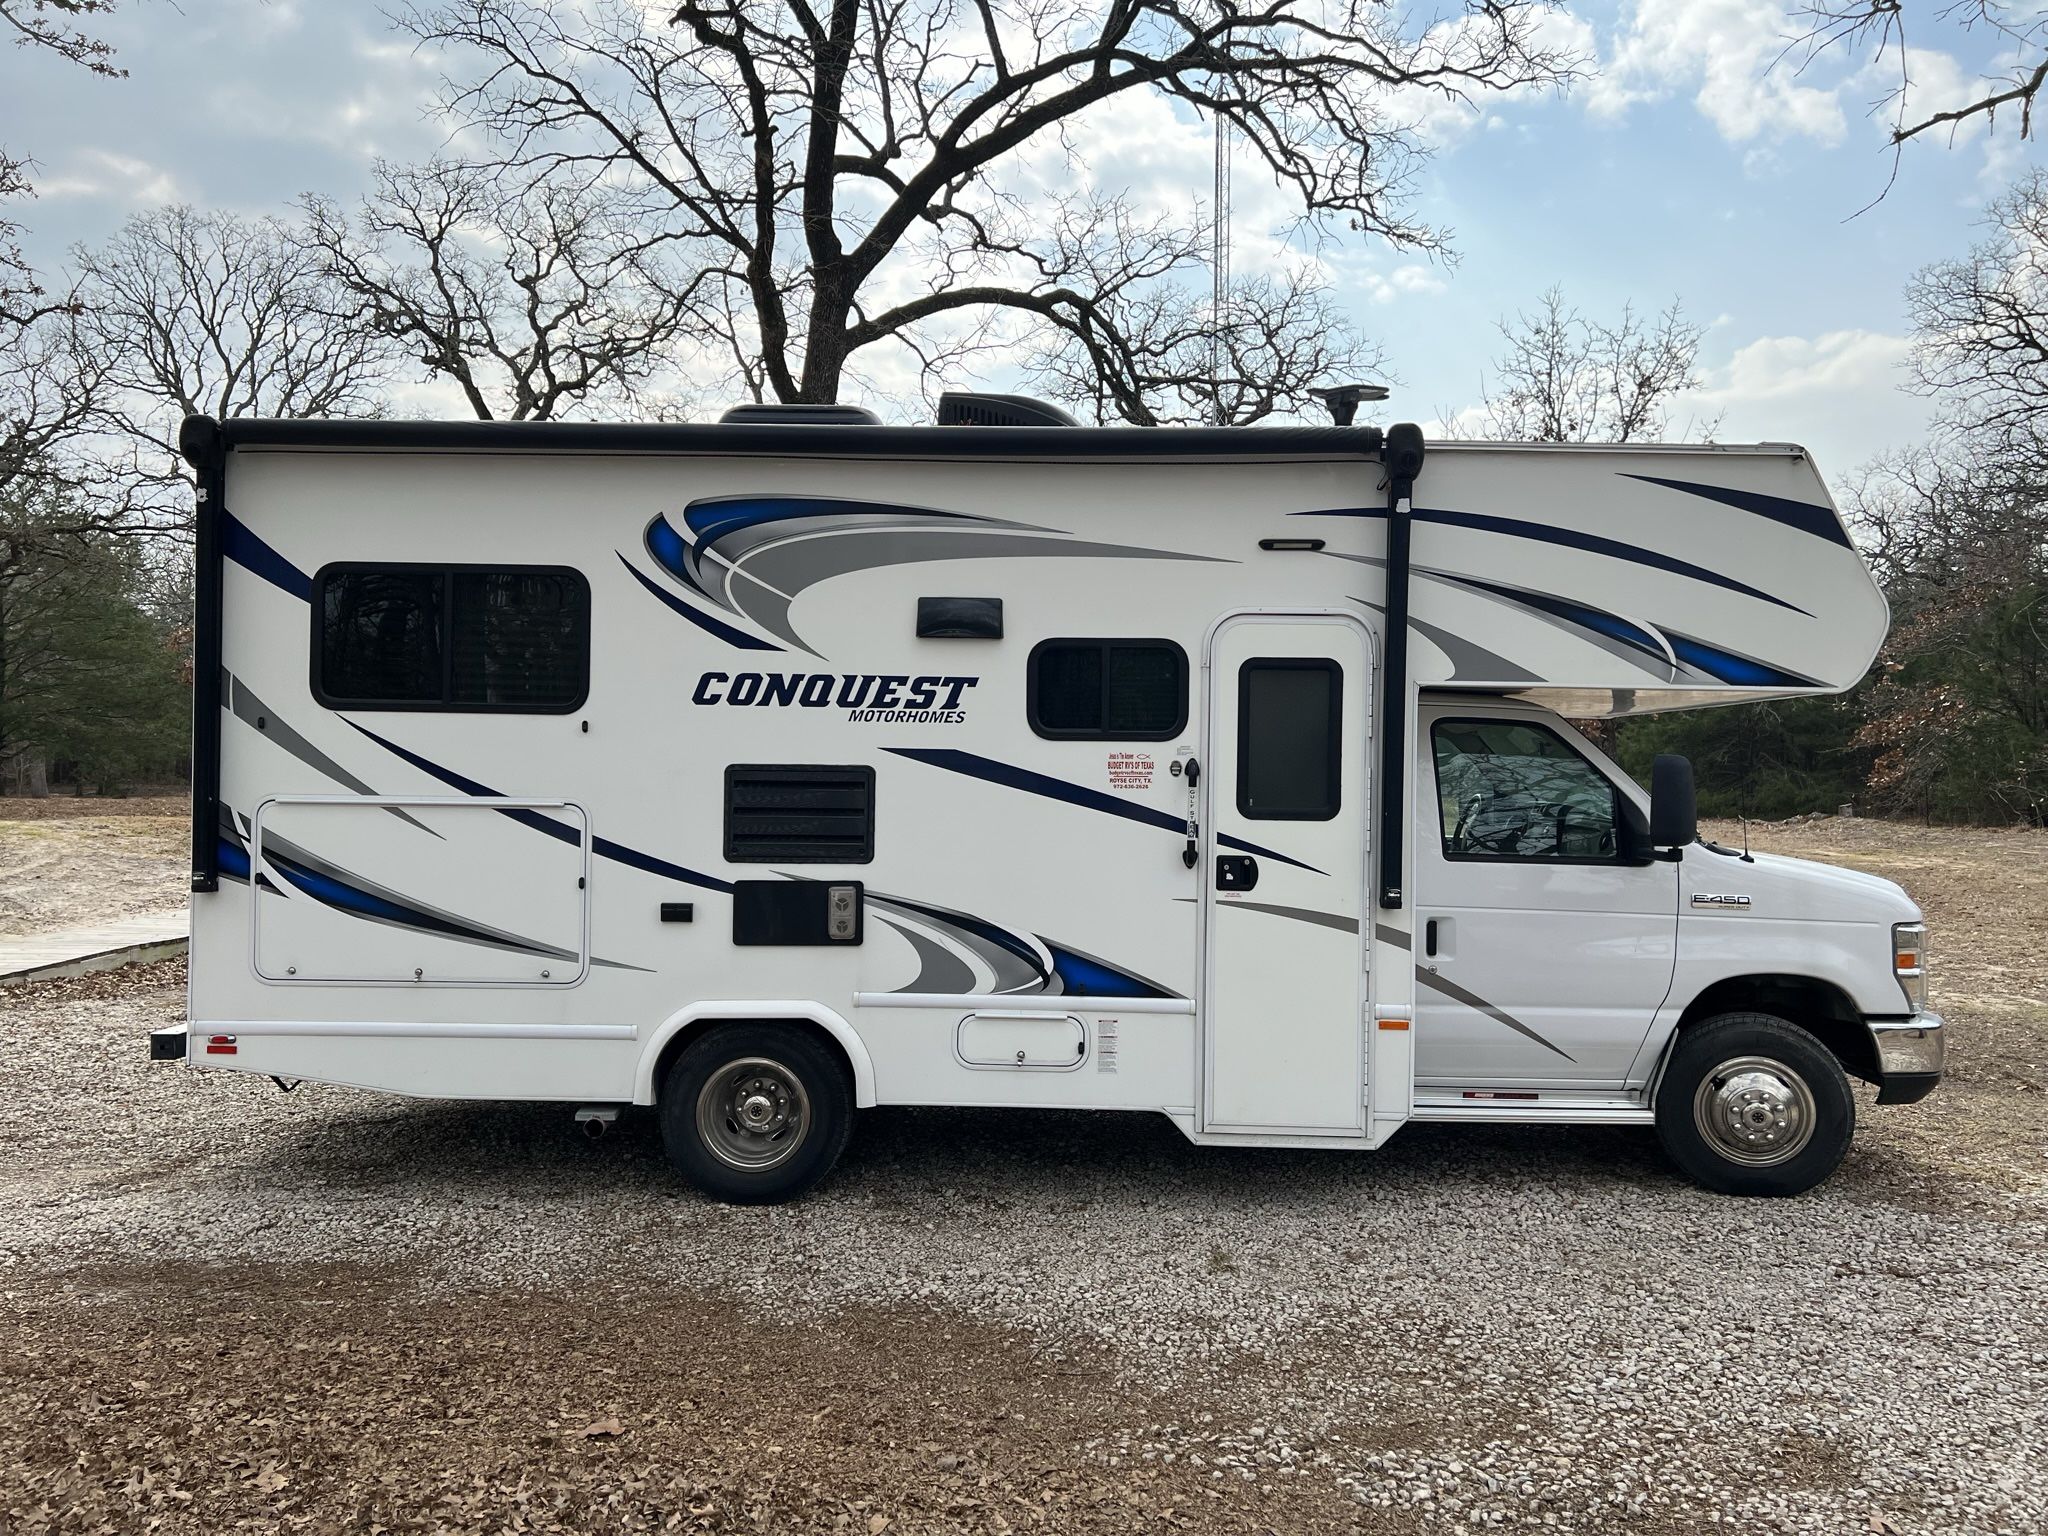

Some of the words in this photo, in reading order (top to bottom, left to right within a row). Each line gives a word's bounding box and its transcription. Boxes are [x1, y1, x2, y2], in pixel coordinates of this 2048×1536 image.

[691, 671, 980, 710] CONQUEST
[848, 709, 966, 724] MOTORHOMES
[1107, 761, 1124, 770] BUDGET
[1135, 761, 1140, 770] OF
[1141, 761, 1155, 770] TEXAS
[1693, 894, 1750, 904] E-450
